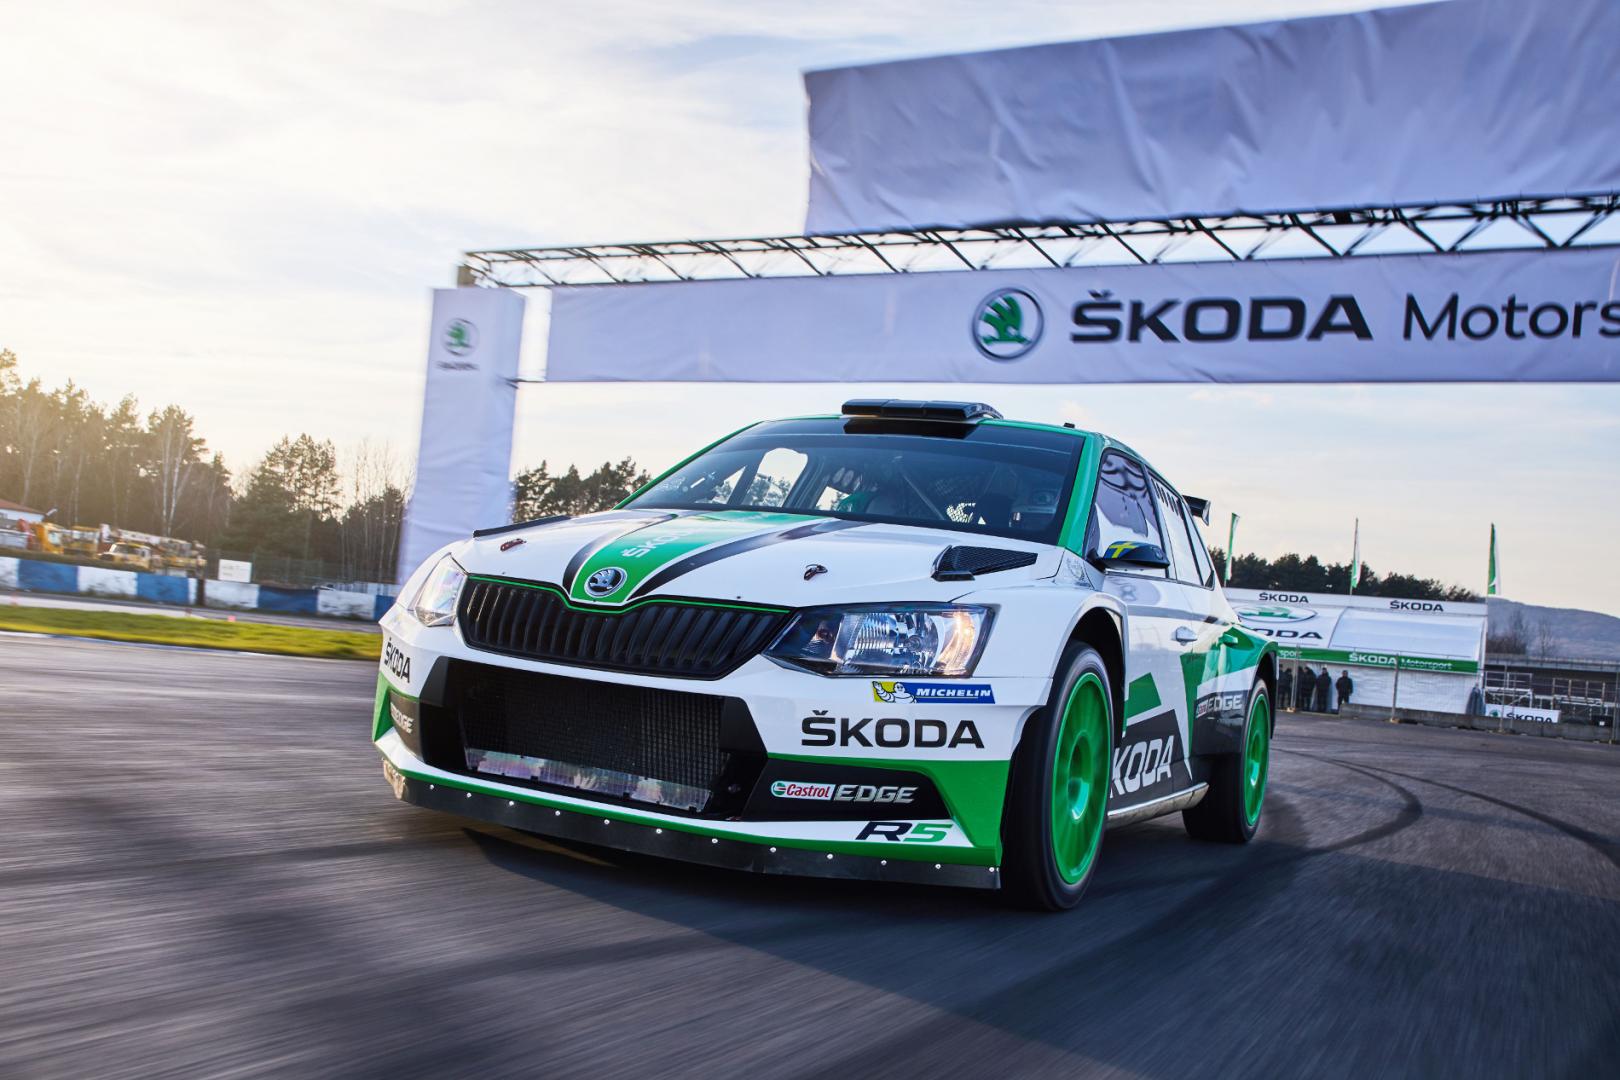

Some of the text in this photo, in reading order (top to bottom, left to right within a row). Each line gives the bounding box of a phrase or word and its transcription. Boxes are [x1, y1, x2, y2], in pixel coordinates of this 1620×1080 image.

[1070, 290, 1373, 344] ŠKODA
[1259, 591, 1309, 603] ŠKODA
[1390, 600, 1444, 612] ŠKODA
[1253, 628, 1323, 639] ODA
[384, 637, 411, 684] ŠKODA
[1348, 652, 1398, 665] ŠKODA
[916, 687, 991, 698] MICHELIN
[1208, 695, 1244, 711] EDGE
[801, 709, 985, 749] ŠKODA
[1110, 735, 1175, 799] KODA
[786, 783, 919, 804] Castrol EDGE
[855, 821, 953, 843] R5
